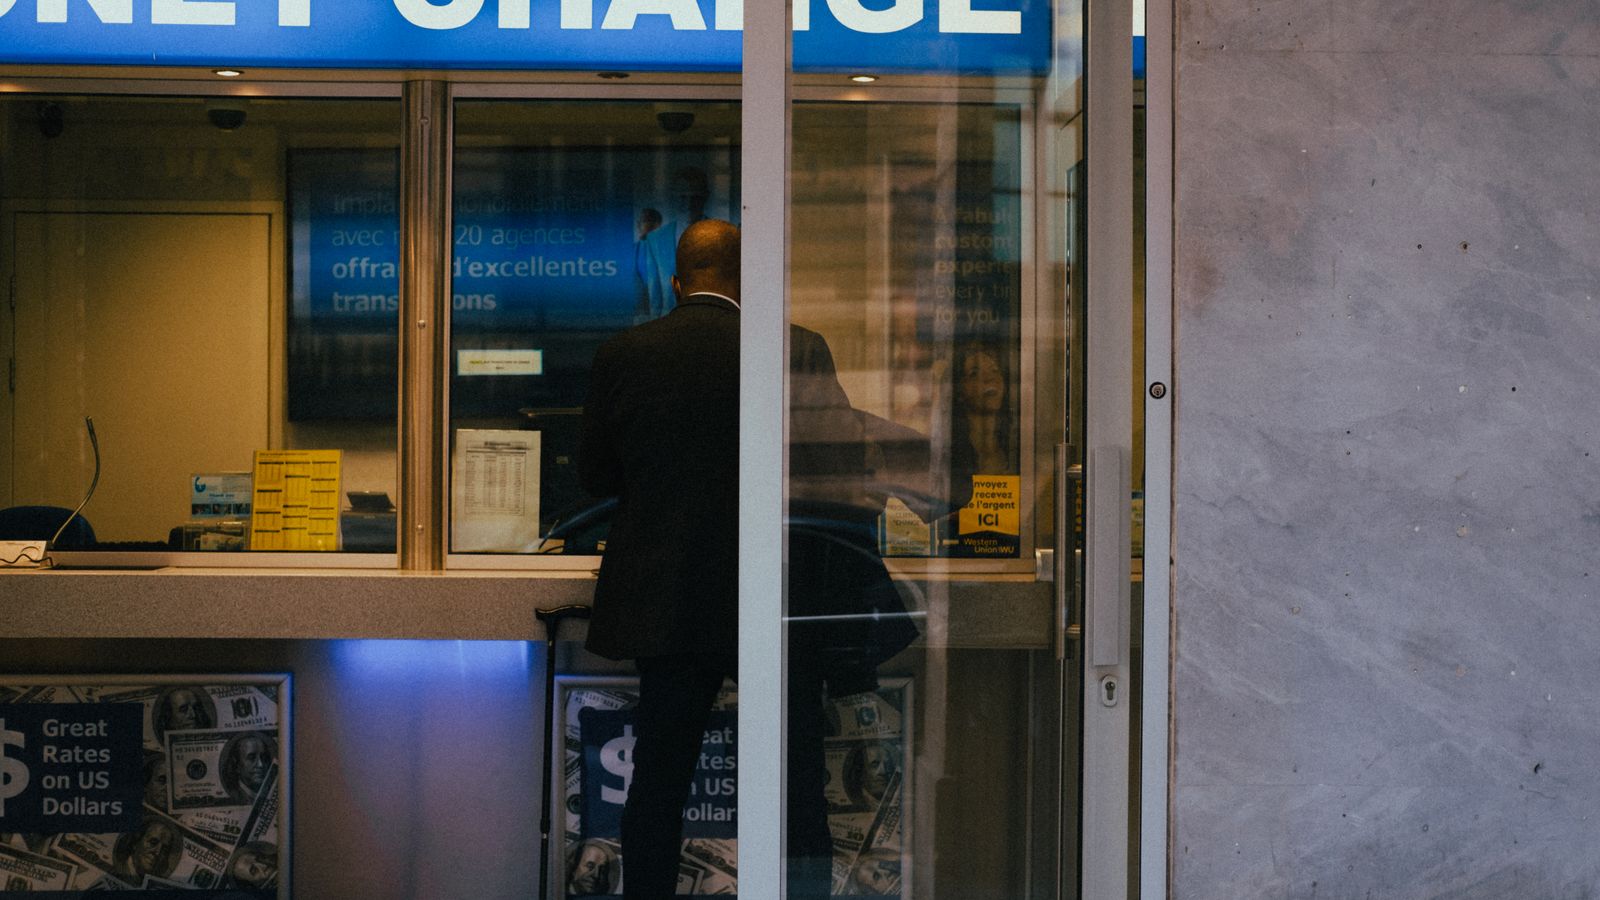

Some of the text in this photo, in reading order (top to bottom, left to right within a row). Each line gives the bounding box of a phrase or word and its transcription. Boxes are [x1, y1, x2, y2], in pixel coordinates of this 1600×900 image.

[332, 229, 384, 246] avec
[491, 227, 585, 250] agences
[332, 256, 400, 279] offra
[974, 481, 1008, 490] nvoyez
[975, 491, 1013, 499] recevez
[977, 500, 1016, 511] l'argent
[978, 513, 999, 527] ICI
[974, 546, 998, 554] Union
[42, 718, 108, 737] Great
[42, 745, 111, 763] Rates
[699, 752, 736, 770] tes
[41, 771, 110, 789] on US
[705, 778, 736, 796] US
[42, 797, 123, 816] Dollars
[681, 803, 737, 821] ollar
